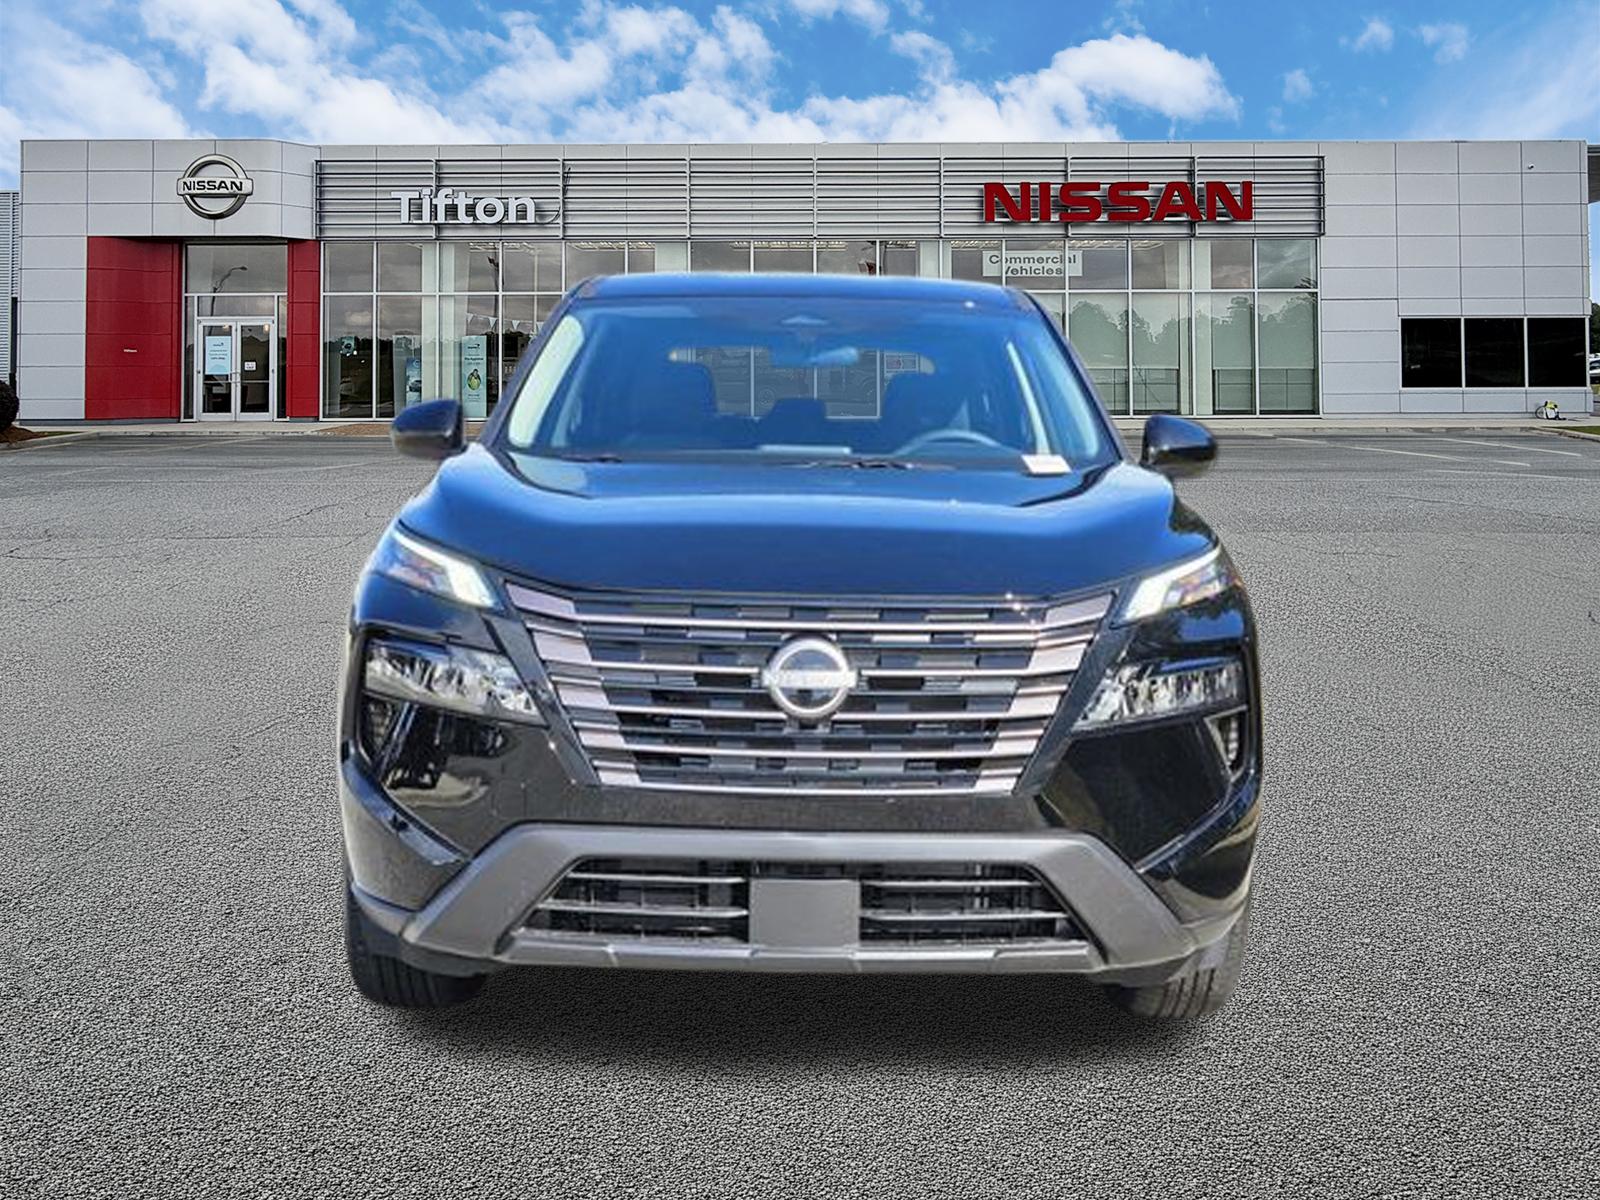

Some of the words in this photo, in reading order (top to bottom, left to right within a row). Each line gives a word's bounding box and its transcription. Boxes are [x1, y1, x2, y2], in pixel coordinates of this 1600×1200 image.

[182, 180, 243, 191] NISSAN
[984, 181, 1253, 222] NISSAN
[391, 188, 536, 224] Tifton
